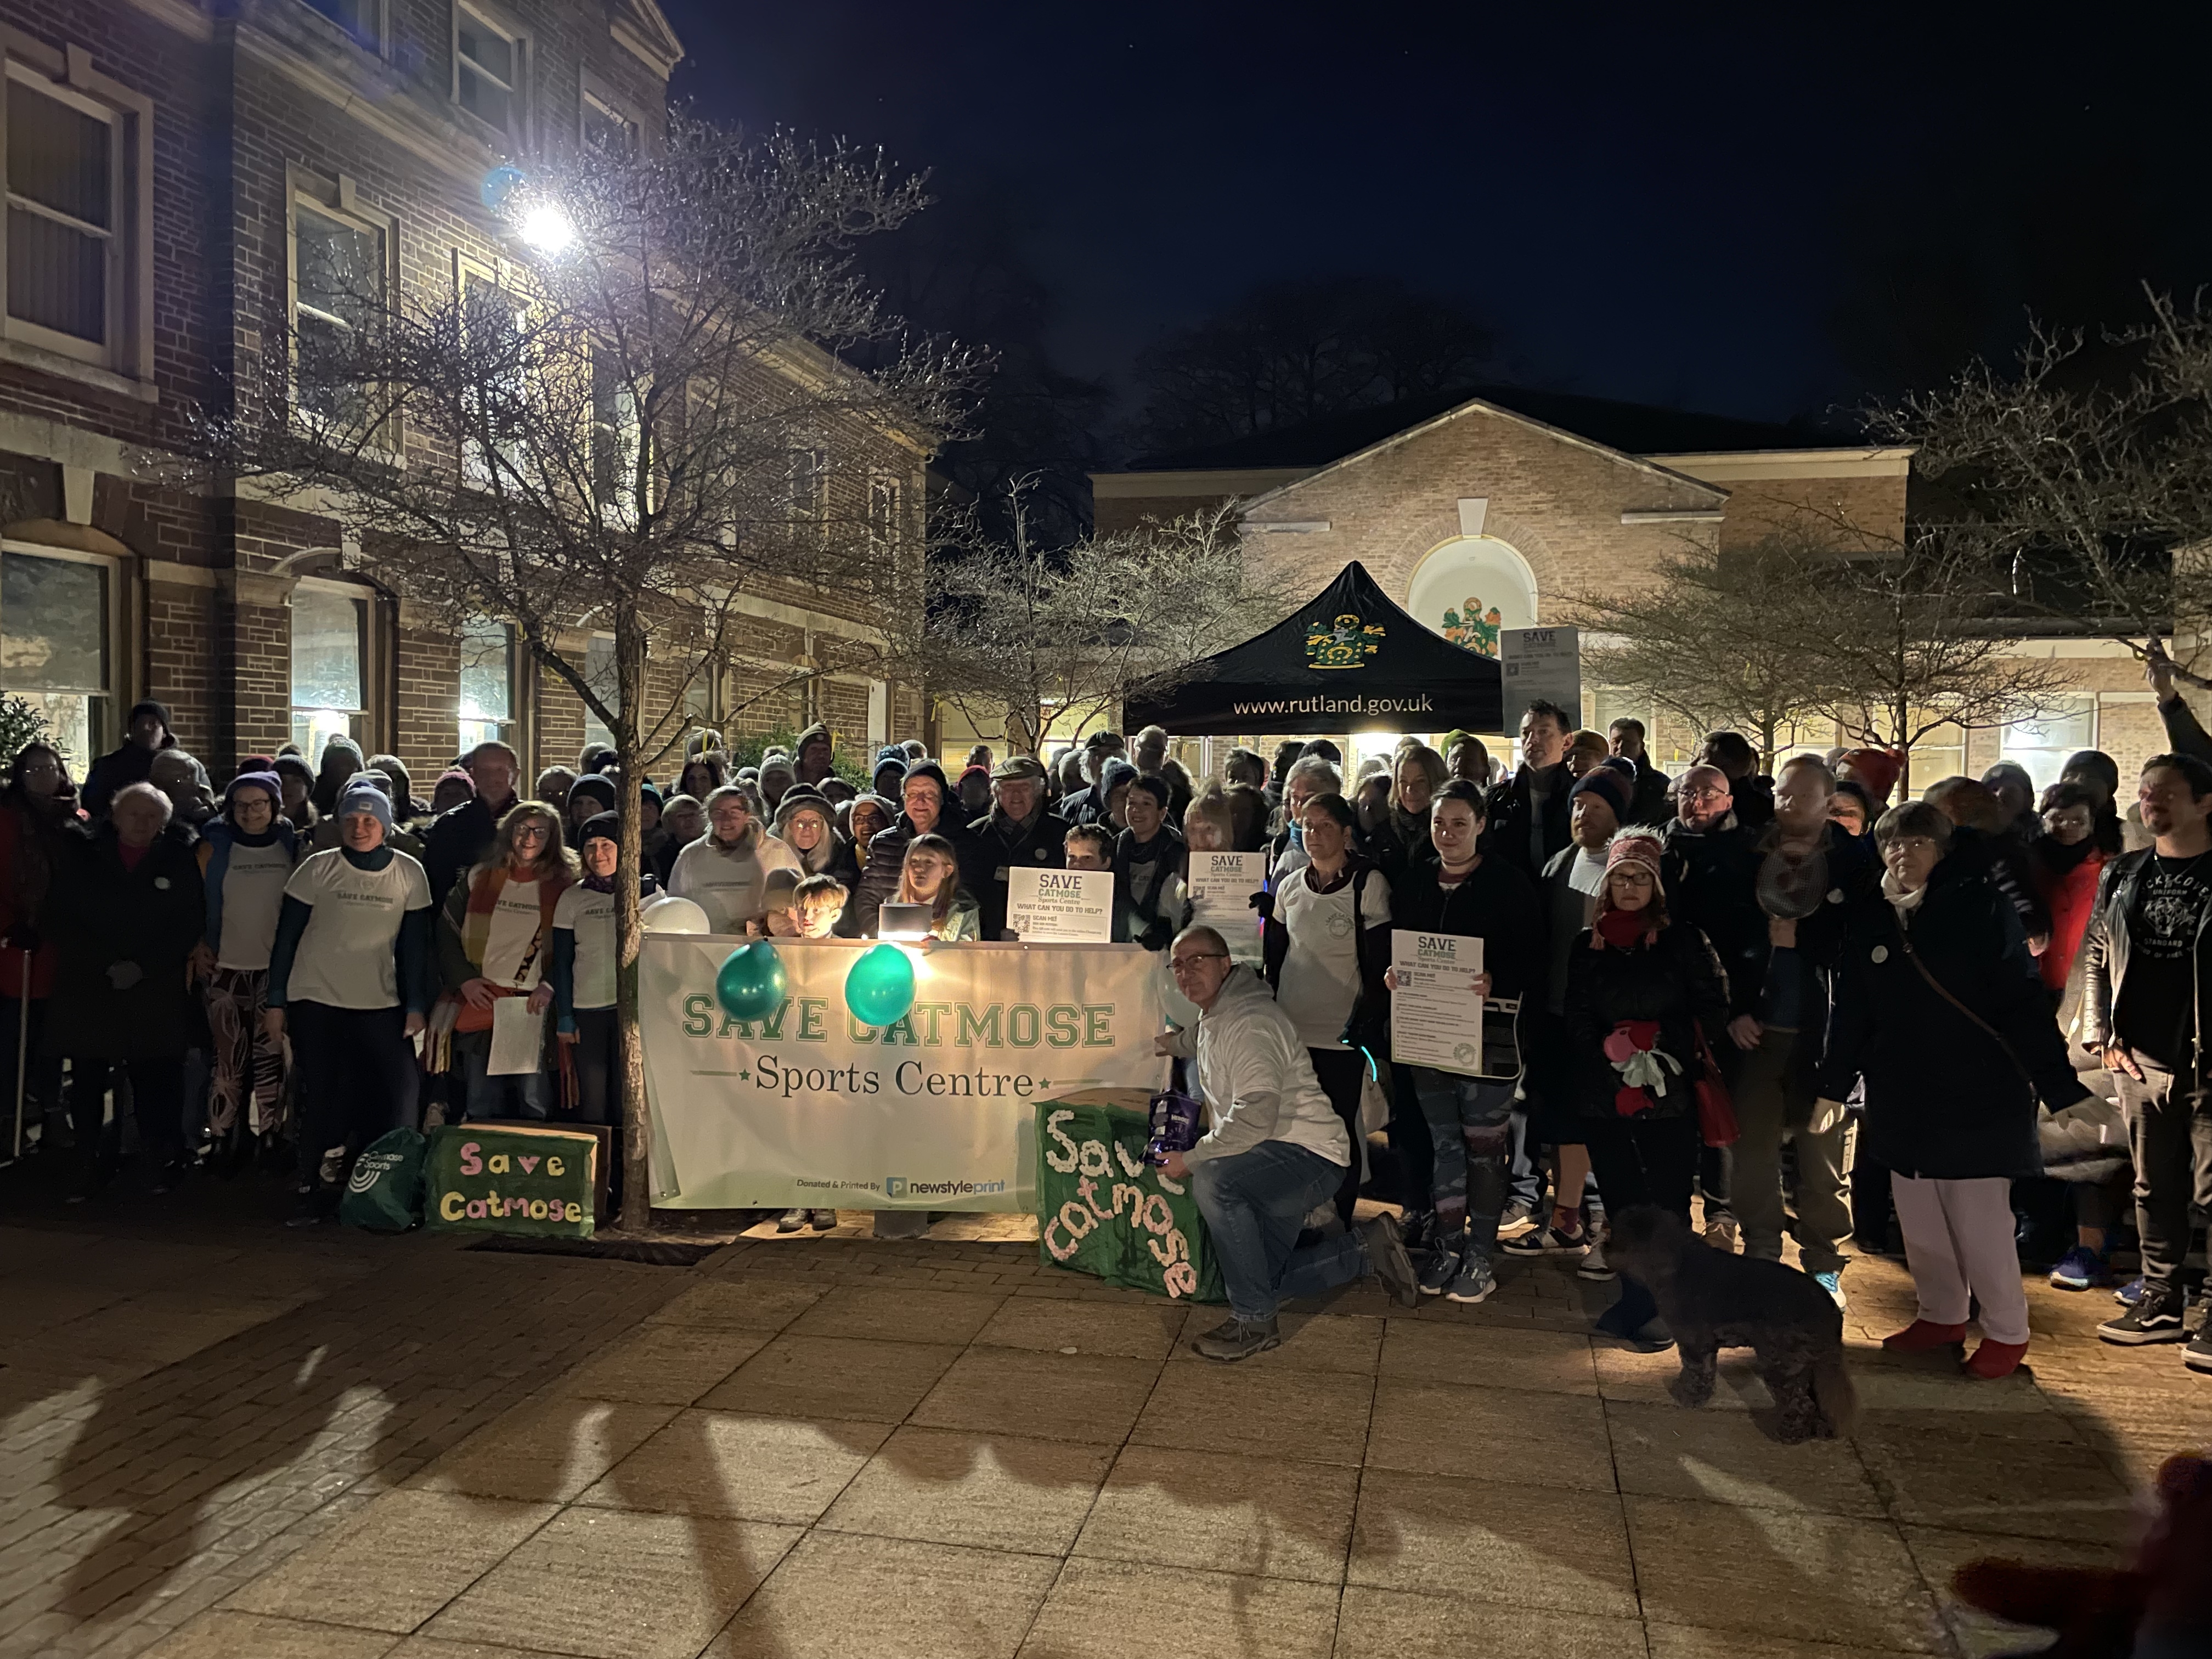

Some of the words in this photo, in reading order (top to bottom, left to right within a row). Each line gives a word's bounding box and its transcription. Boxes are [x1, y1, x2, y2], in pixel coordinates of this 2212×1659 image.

[1523, 631, 1556, 642] SAVE
[1234, 694, 1433, 715] www.rutland.gov.uk
[1211, 855, 1243, 866] SAVE
[1040, 874, 1082, 889] SAVE
[1039, 888, 1081, 899] CATMOSE
[1418, 936, 1457, 951] SAVE
[1418, 949, 1456, 959] CATMOSE
[757, 1055, 879, 1098] Sports
[896, 1061, 1033, 1096] Centre
[460, 1142, 565, 1176] Save
[797, 1179, 831, 1188] Donated
[840, 1181, 868, 1189] Printed
[870, 1182, 880, 1191] By
[910, 1179, 1005, 1195] newstyleprint
[440, 1190, 581, 1222] Catmose
